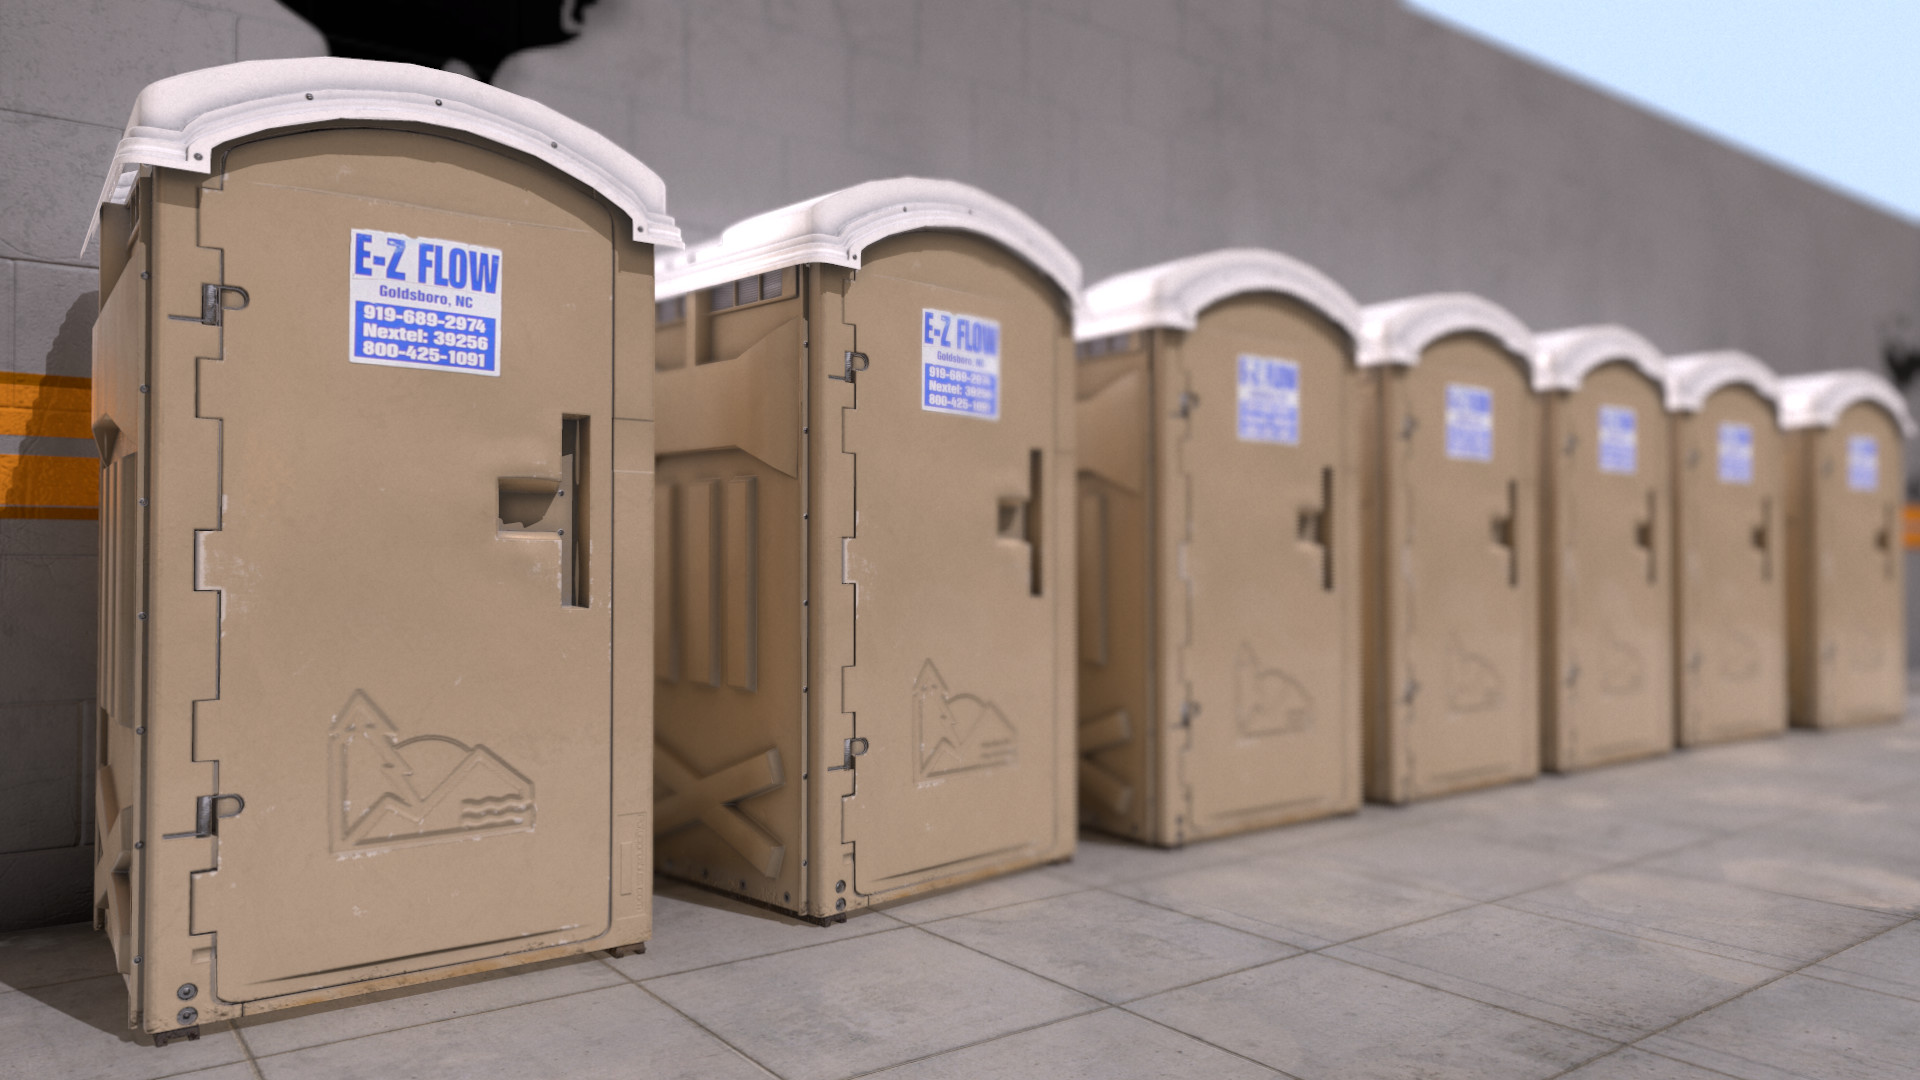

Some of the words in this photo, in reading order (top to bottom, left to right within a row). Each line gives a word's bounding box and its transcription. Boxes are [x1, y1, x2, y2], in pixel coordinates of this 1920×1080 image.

[355, 233, 406, 281] E-Z
[418, 243, 500, 294] FLOW
[379, 285, 452, 307] Goldsboro,
[456, 295, 474, 309] NC
[363, 304, 487, 334] 919-689-2974
[924, 311, 951, 348] E-Z
[362, 322, 429, 344] Nextel:
[433, 331, 489, 351] 39256
[362, 340, 486, 368] 800-425-1091
[928, 366, 991, 386] 919-689-2
[928, 380, 963, 396] Nextel:
[928, 394, 991, 412] 800-425-1
